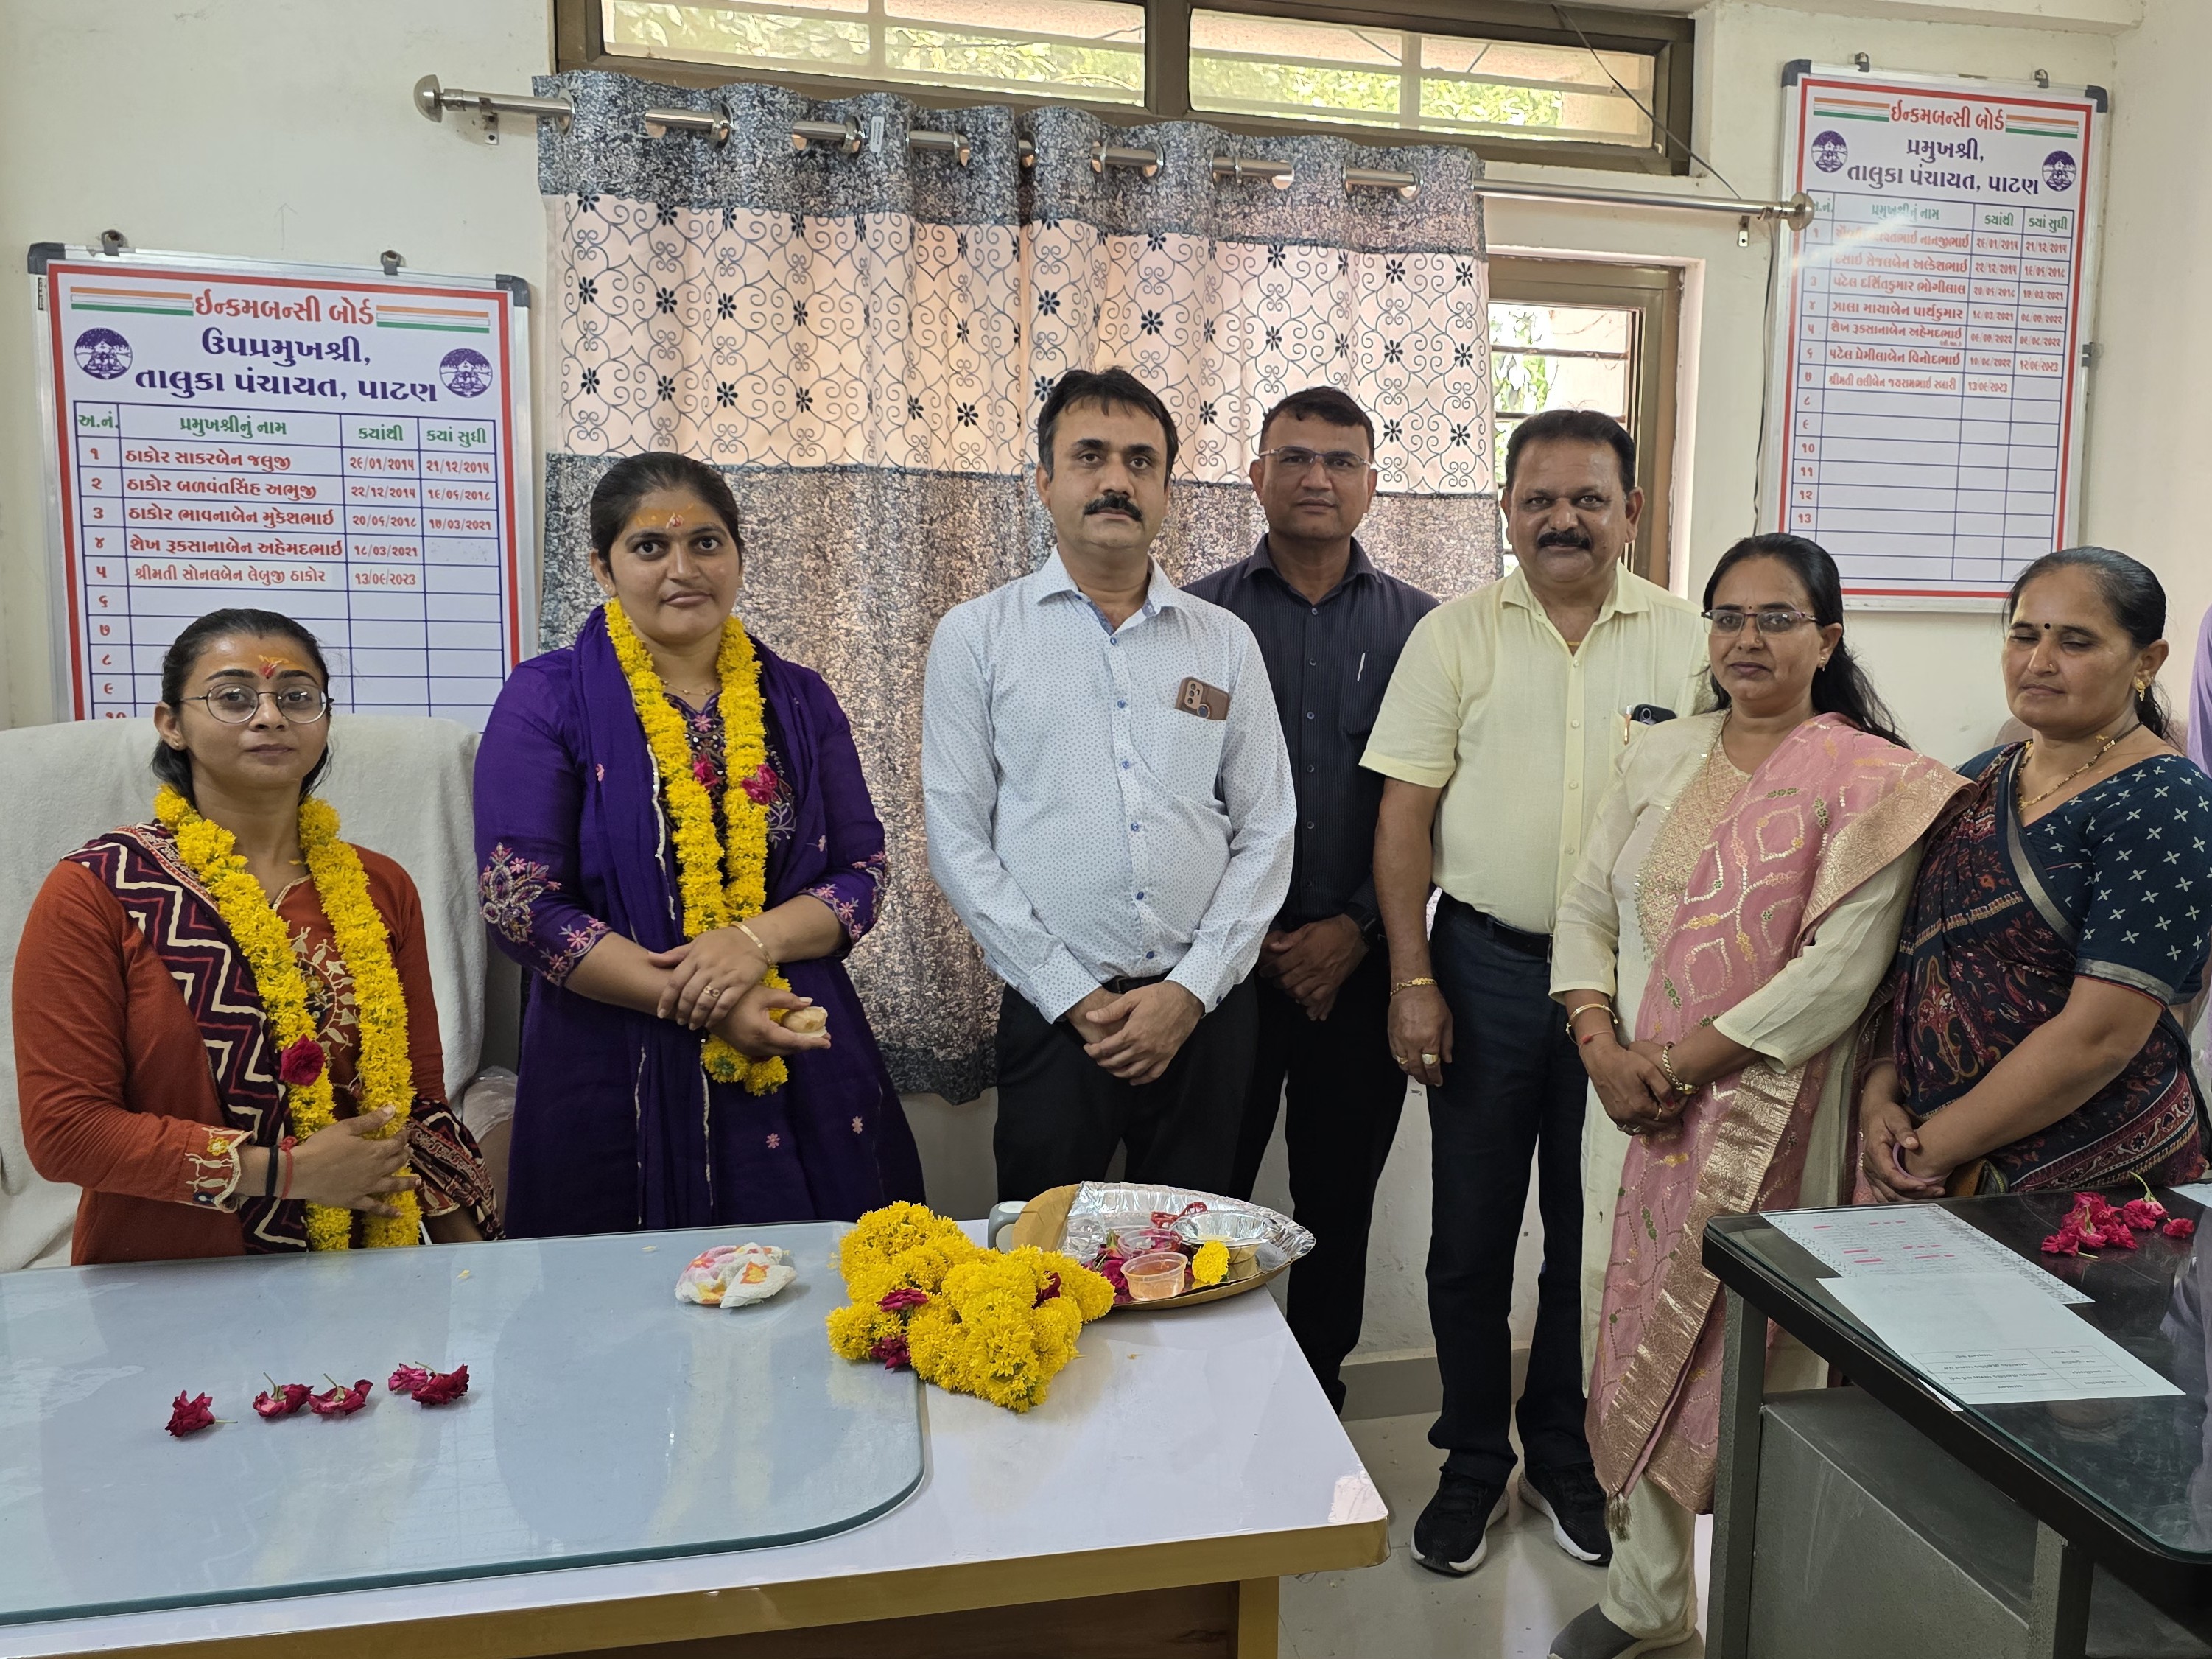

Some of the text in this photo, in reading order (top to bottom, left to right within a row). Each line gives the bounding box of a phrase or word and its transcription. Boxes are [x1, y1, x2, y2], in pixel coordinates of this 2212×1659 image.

[1976, 107, 2004, 133] બોર્ડ
[1906, 138, 1984, 165] પ્રમુખશ્રી,
[1847, 164, 2038, 194] તાલુકા પંચાયત, પાટણ
[1920, 208, 1939, 220] નામ
[2048, 216, 2068, 233] સુધી
[329, 296, 373, 324] બોર્ડ
[202, 327, 370, 367] ઉપપ્રમુખશ્રી,
[136, 367, 437, 402] તાલુકા પંચાયત, પાટણ
[180, 415, 253, 438] પ્રમુખશ્રીનું
[257, 422, 287, 435] નામ
[458, 428, 486, 448] સુધી
[90, 448, 99, 460] ૧
[125, 446, 170, 463] ઠાકોર
[175, 449, 242, 466] સાકરબેન
[247, 455, 291, 472] જલુજી
[1802, 443, 1815, 453] ૧૦
[1801, 467, 1813, 477] ૧૧
[91, 478, 102, 490] ૨
[127, 474, 172, 491] ઠાકોર
[177, 477, 260, 496] બળવંતસિંહ
[1800, 490, 1812, 499] ૧૨
[94, 508, 103, 519] ૩
[129, 503, 173, 520] ઠાકોર
[178, 506, 258, 523] ભાવનાબેન
[263, 507, 334, 529] મુકેશભાઈ
[1798, 513, 1811, 523] ૧૩
[95, 537, 105, 548] ૪
[130, 534, 161, 551] શેખ
[257, 538, 342, 555] અહેમદભાઈ
[96, 566, 107, 578] ૫
[135, 564, 177, 580] શ્રીમતી
[183, 564, 242, 581] સોનલબેન
[290, 566, 326, 581] ઠાકોર
[99, 595, 108, 608] ૬
[100, 625, 110, 636] ૭
[102, 654, 111, 665] ૮
[104, 683, 113, 694] ૯
